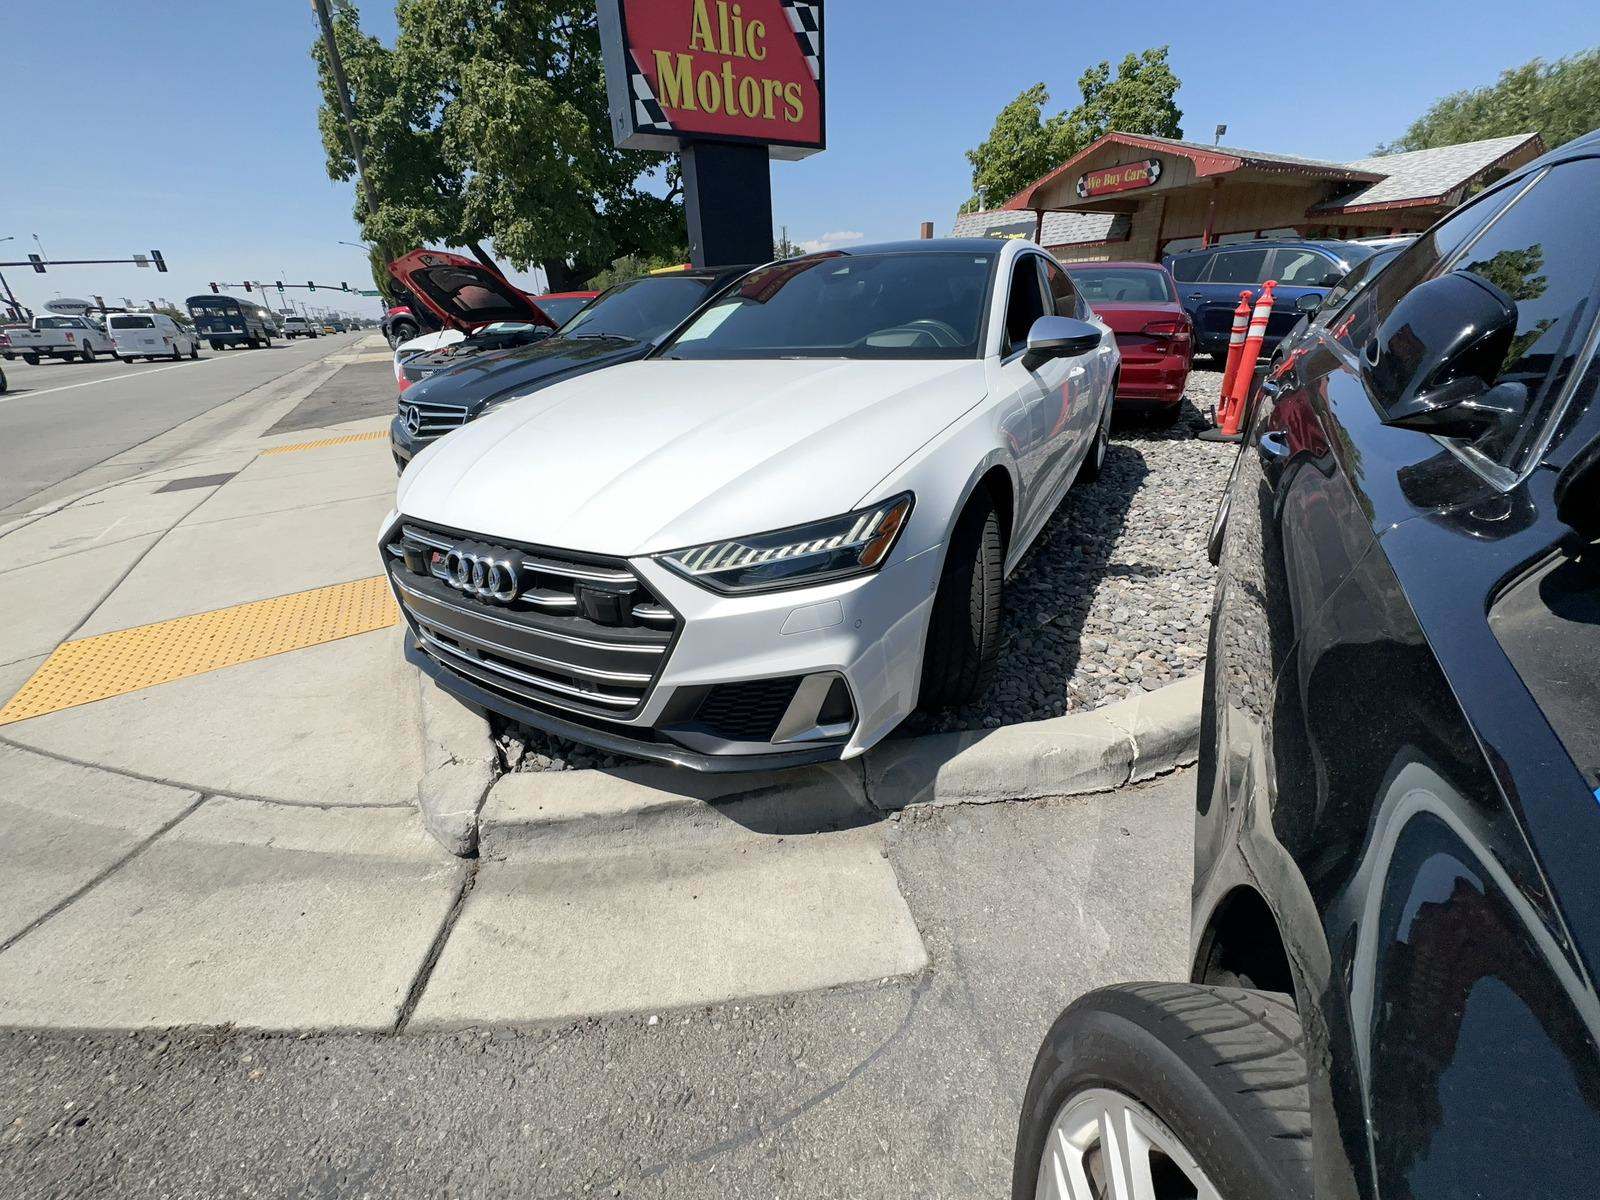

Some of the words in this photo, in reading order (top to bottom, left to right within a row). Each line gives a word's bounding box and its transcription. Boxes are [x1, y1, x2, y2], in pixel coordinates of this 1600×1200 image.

[689, 0, 767, 61] Alic
[652, 49, 804, 123] Motors
[1088, 176, 1101, 189] We
[1104, 173, 1121, 186] Buy
[1124, 168, 1148, 182] Cars
